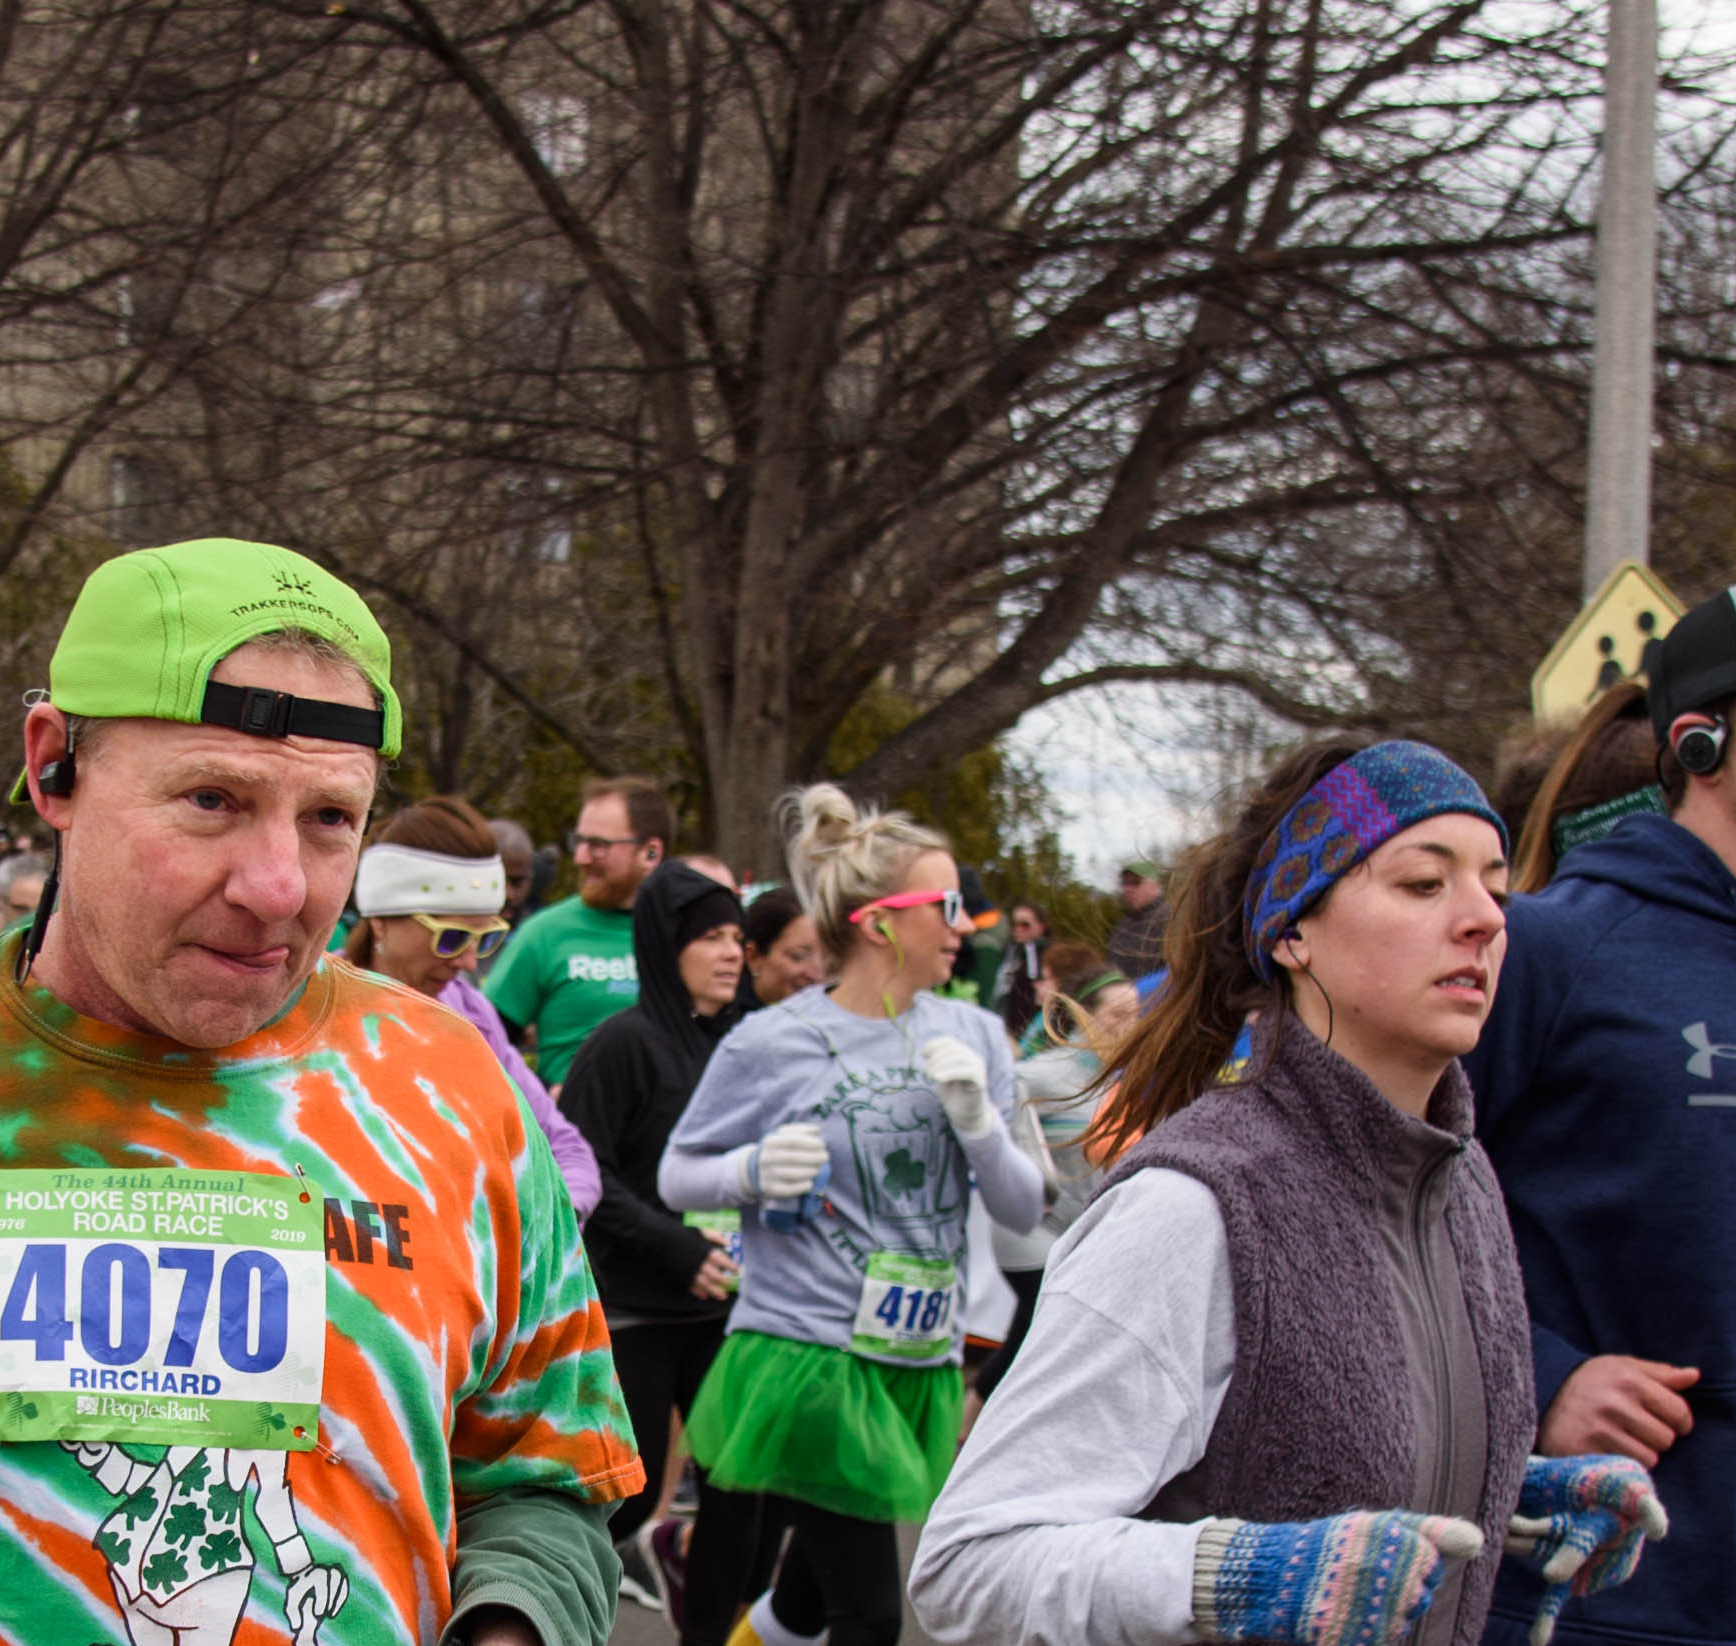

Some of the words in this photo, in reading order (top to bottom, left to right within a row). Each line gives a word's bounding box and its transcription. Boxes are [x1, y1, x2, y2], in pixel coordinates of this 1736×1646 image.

[52, 1173, 94, 1190] The
[101, 1174, 152, 1190] 44th
[158, 1175, 245, 1193] Annual
[4, 1190, 126, 1213] HOLYOKE
[129, 1191, 290, 1222] ST.PATRICK'S
[71, 1211, 147, 1235] ROAD
[152, 1213, 224, 1238] RACE
[269, 1228, 307, 1244] 2019
[68, 1367, 223, 1396] RIRCHARD
[101, 1396, 213, 1425] PeoplesBank
